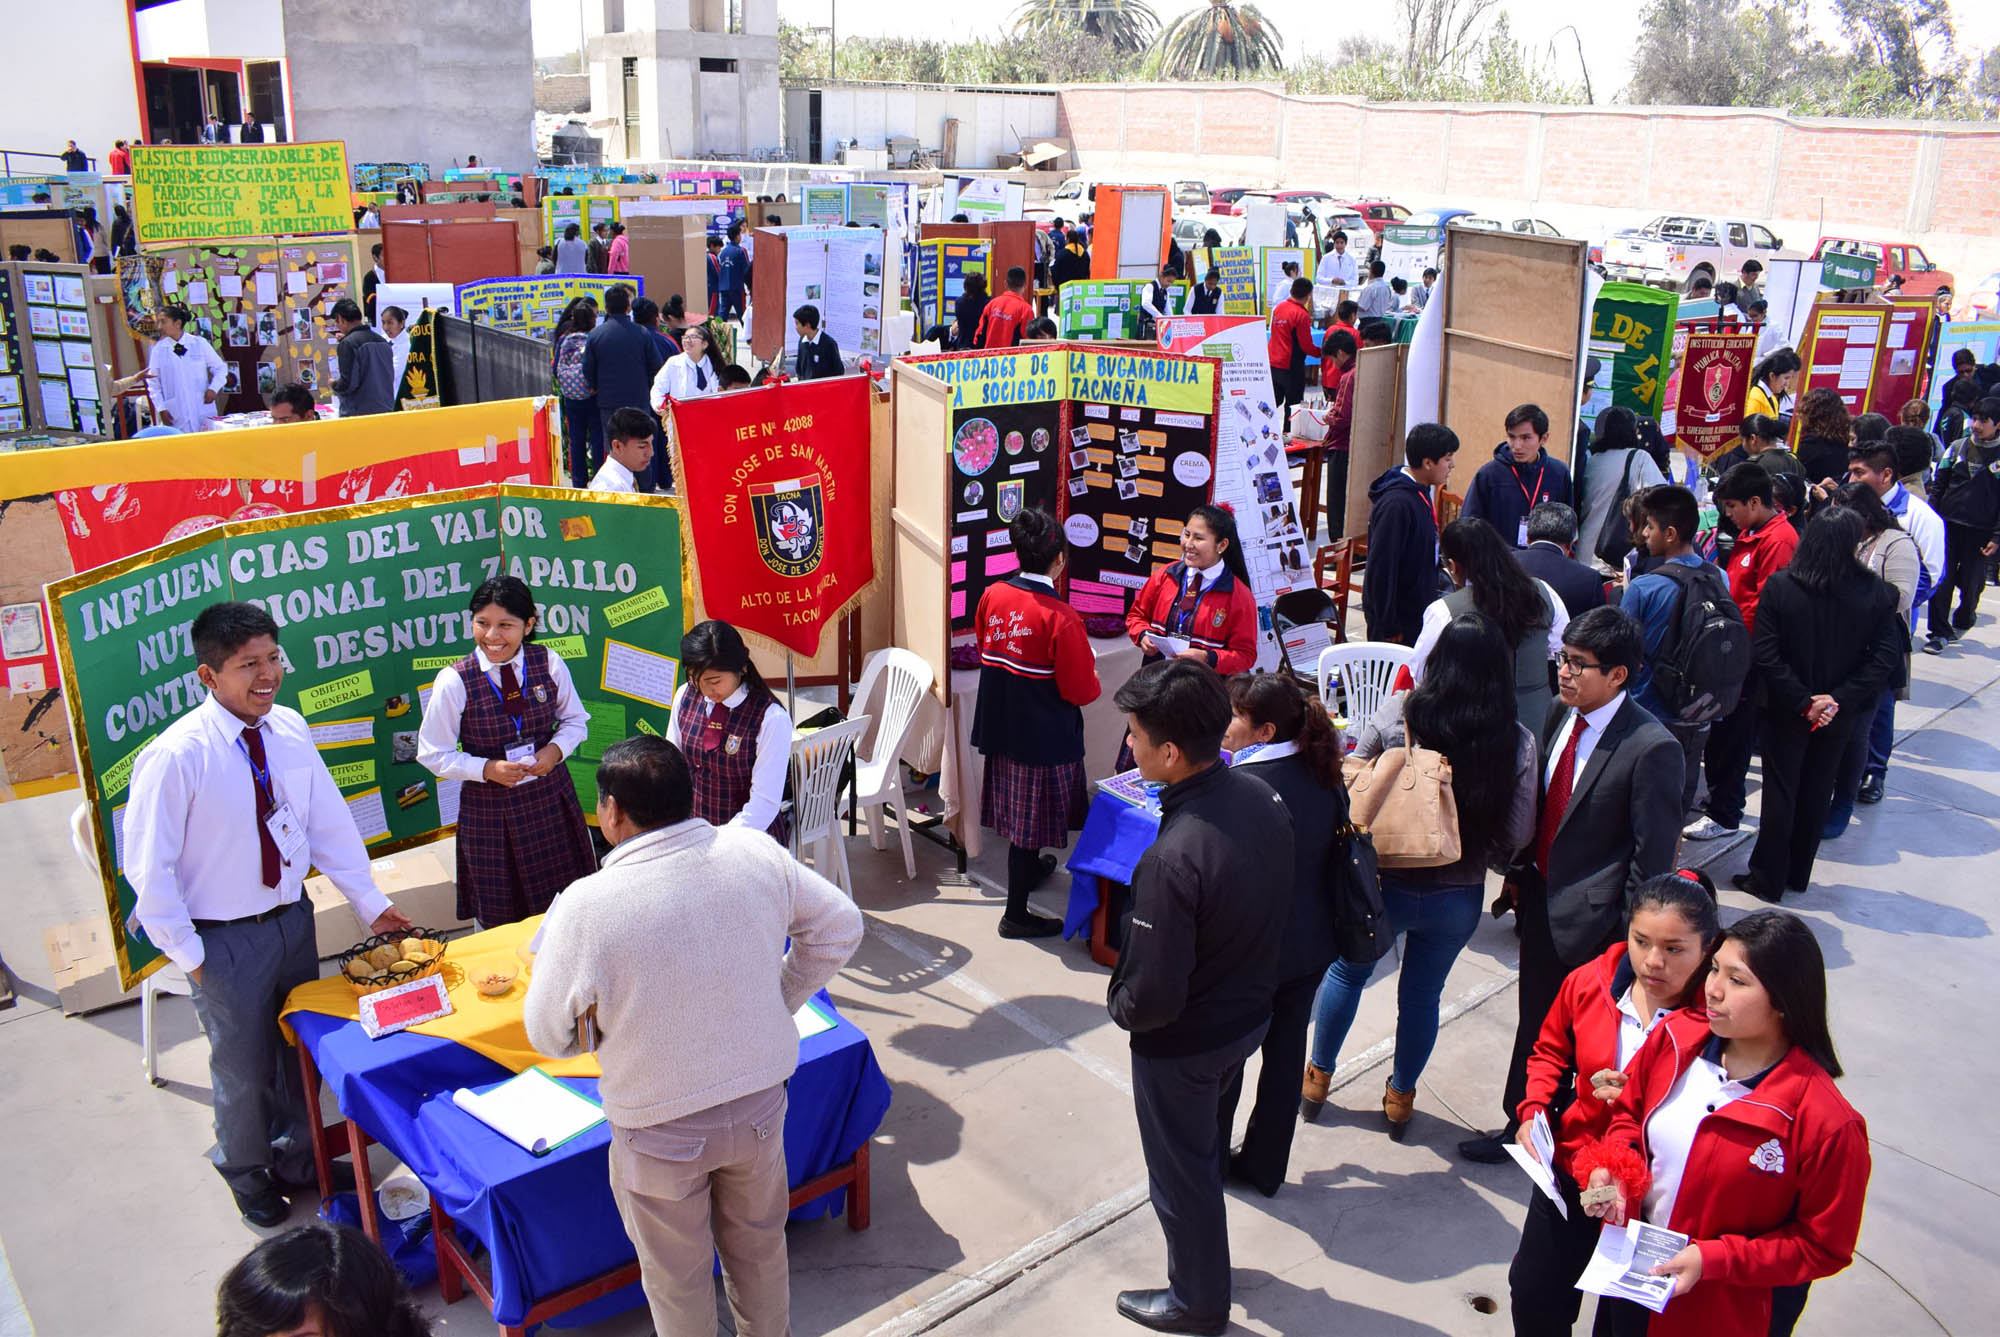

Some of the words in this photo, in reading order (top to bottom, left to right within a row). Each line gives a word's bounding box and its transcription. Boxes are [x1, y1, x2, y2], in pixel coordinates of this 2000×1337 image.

[320, 147, 341, 162] DE
[277, 168, 297, 182] DE
[299, 166, 341, 182] MUSA
[261, 185, 297, 200] PARA
[315, 183, 334, 198] LA
[258, 200, 279, 215] DE
[296, 199, 316, 213] LA
[260, 216, 350, 234] AMBIENTAL
[1609, 313, 1653, 350] DE
[1031, 352, 1049, 375] DE
[1070, 352, 1087, 375] LA
[1097, 359, 1199, 385] BUGAMBILIA
[982, 378, 1056, 403] SOCIEDAD
[1072, 377, 1147, 405] TACNEÑA
[736, 425, 758, 442] IEE
[783, 415, 813, 433] 42088
[731, 454, 761, 487] JOSE
[765, 445, 784, 461] DE
[790, 443, 814, 461] SAN
[815, 454, 836, 501] MARTIN
[776, 491, 801, 501] TACNA
[346, 521, 419, 564] DEL
[431, 506, 547, 546] VALOR
[791, 565, 801, 574] DE
[402, 562, 471, 601] DEL
[608, 591, 657, 614] TRATAMIENTO
[741, 591, 772, 609] ALTO
[776, 591, 791, 604] DE
[797, 587, 813, 602] LA
[610, 600, 664, 626] ENFERMEDADES
[310, 676, 360, 698] OBJETIVO
[314, 689, 362, 710] GENERAL
